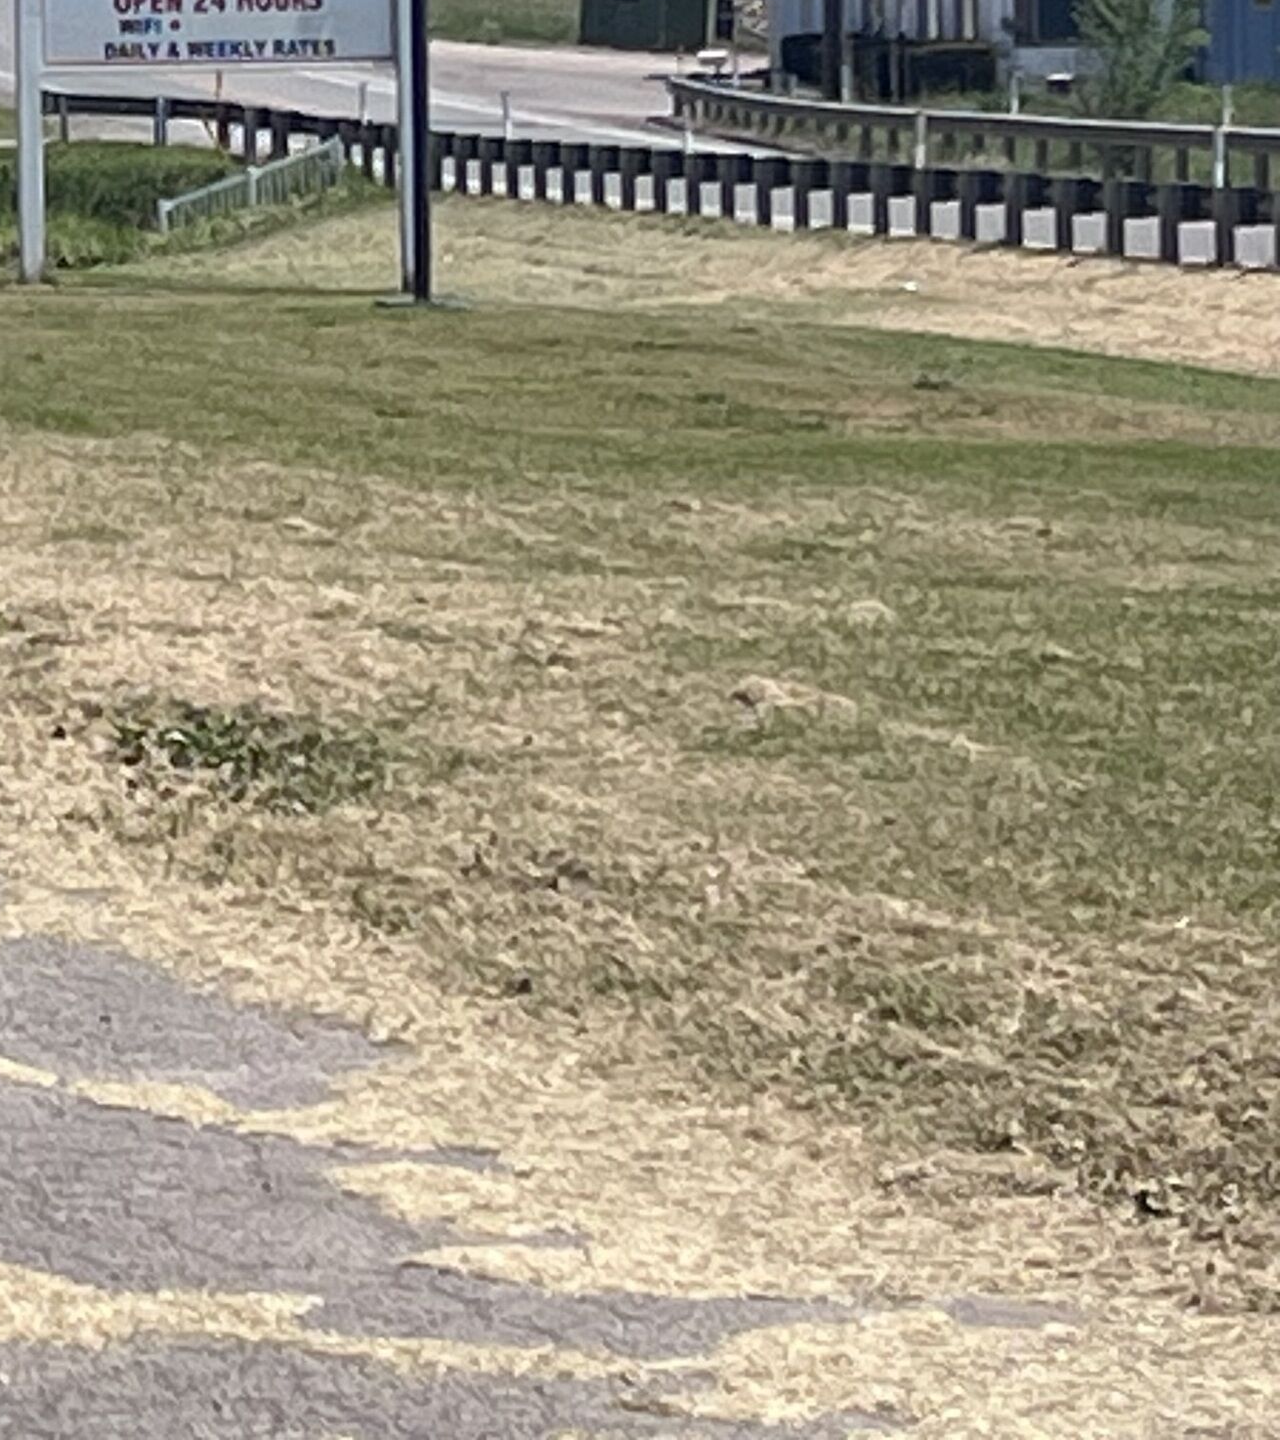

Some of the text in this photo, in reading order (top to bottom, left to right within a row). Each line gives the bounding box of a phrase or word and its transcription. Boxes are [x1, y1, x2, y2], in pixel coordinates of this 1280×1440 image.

[104, 39, 335, 60] DAILY & WEEKLY RATES
